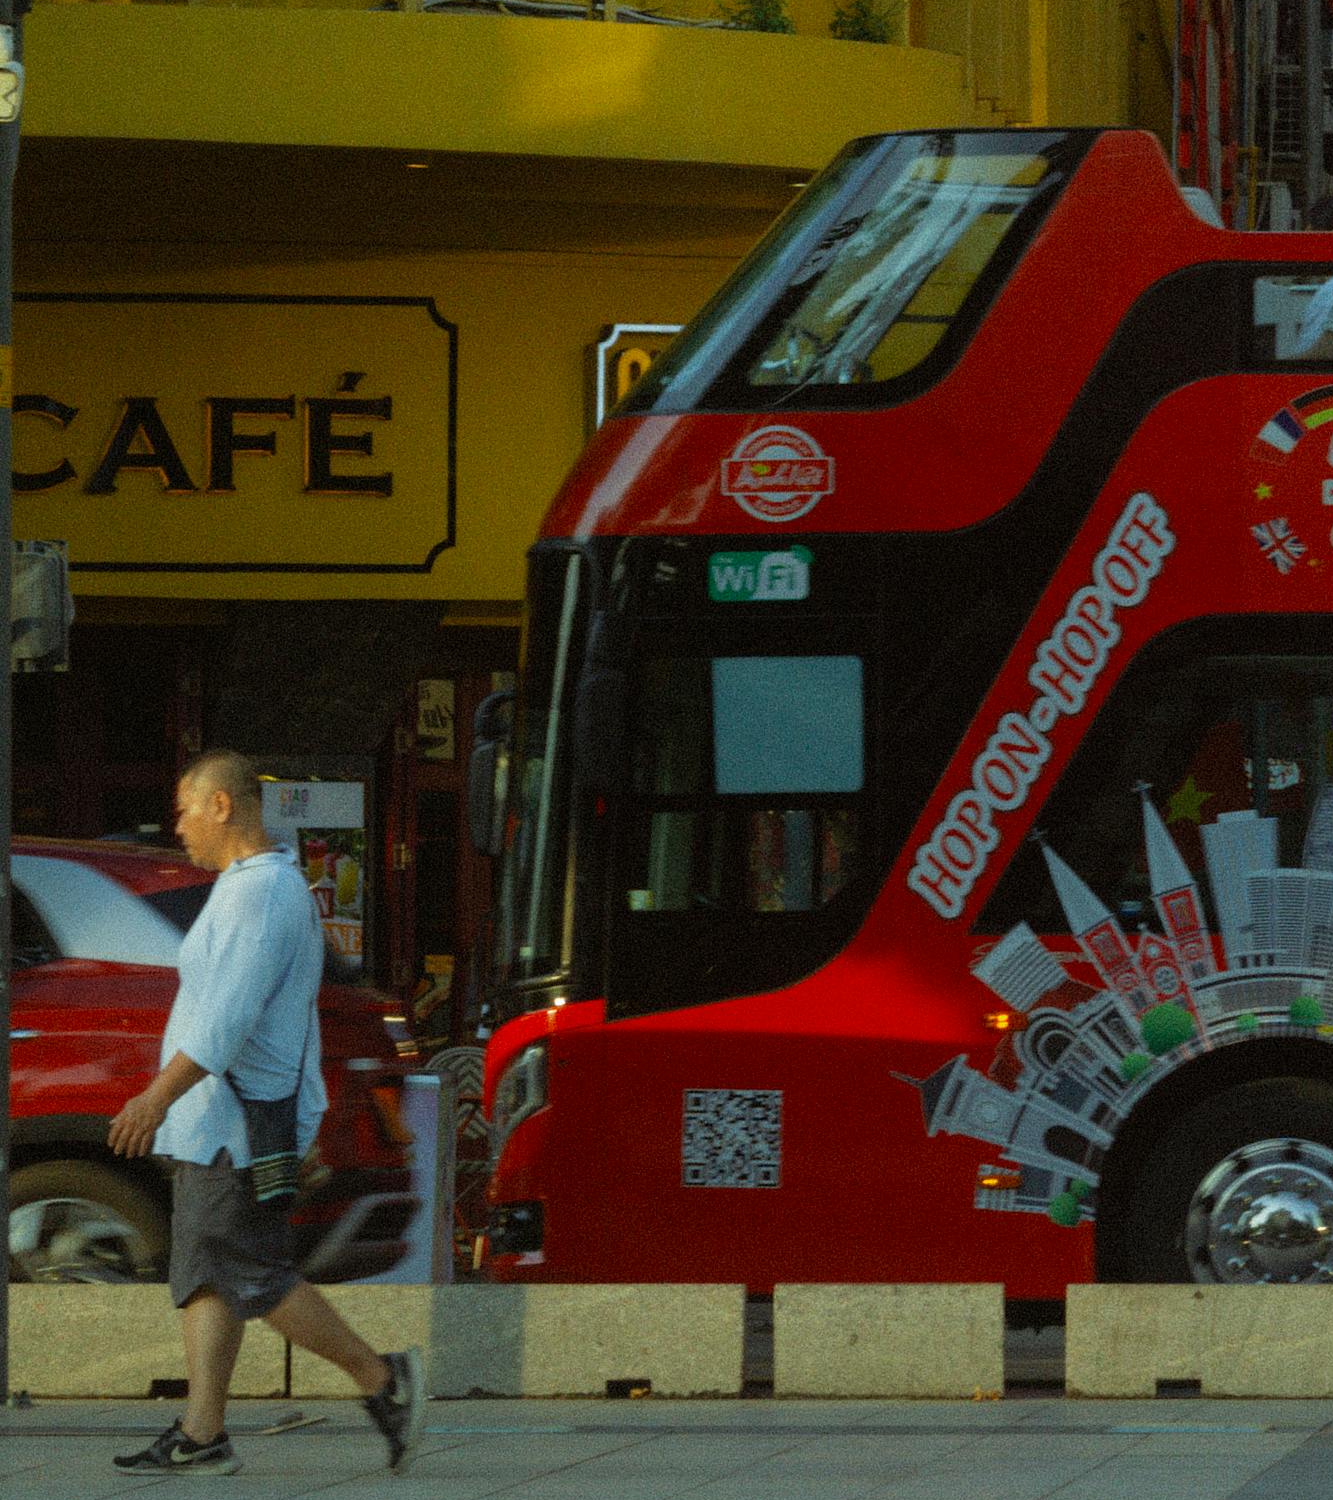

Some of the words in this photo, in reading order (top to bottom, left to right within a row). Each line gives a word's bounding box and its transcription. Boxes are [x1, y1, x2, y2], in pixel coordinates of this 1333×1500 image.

[12, 371, 394, 497] CAFÉ
[907, 791, 999, 919] HOP
[1094, 492, 1175, 607] OFF
